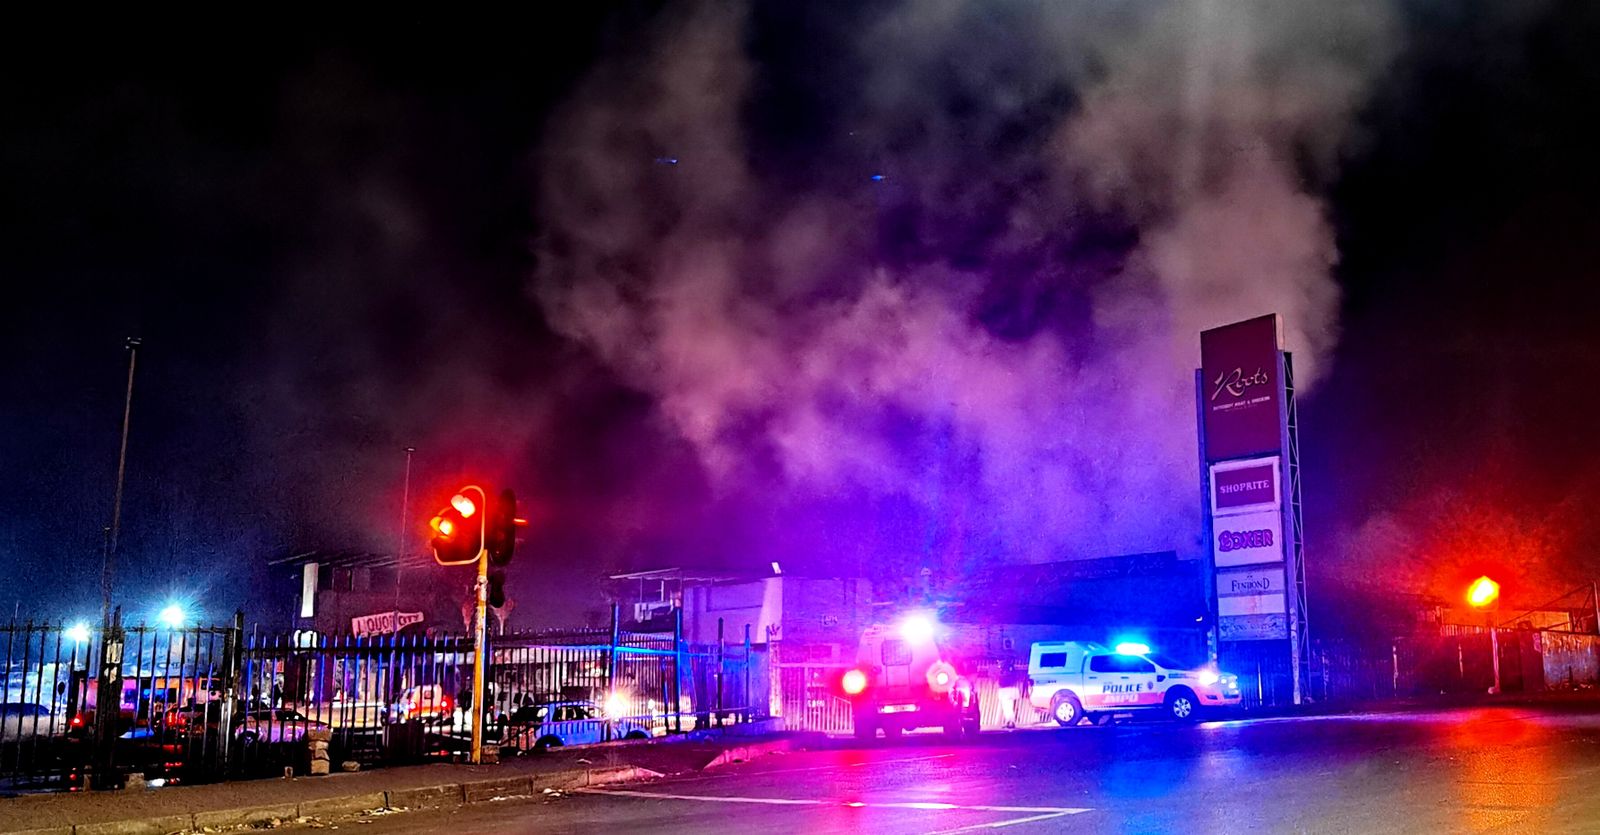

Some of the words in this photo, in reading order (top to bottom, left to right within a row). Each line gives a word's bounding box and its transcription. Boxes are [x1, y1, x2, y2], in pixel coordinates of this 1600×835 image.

[1211, 367, 1268, 401] Roots
[1219, 479, 1270, 494] SHOPRITE
[357, 615, 395, 633] LQUO
[398, 614, 419, 626] CITY
[1103, 682, 1143, 693] POLICE
